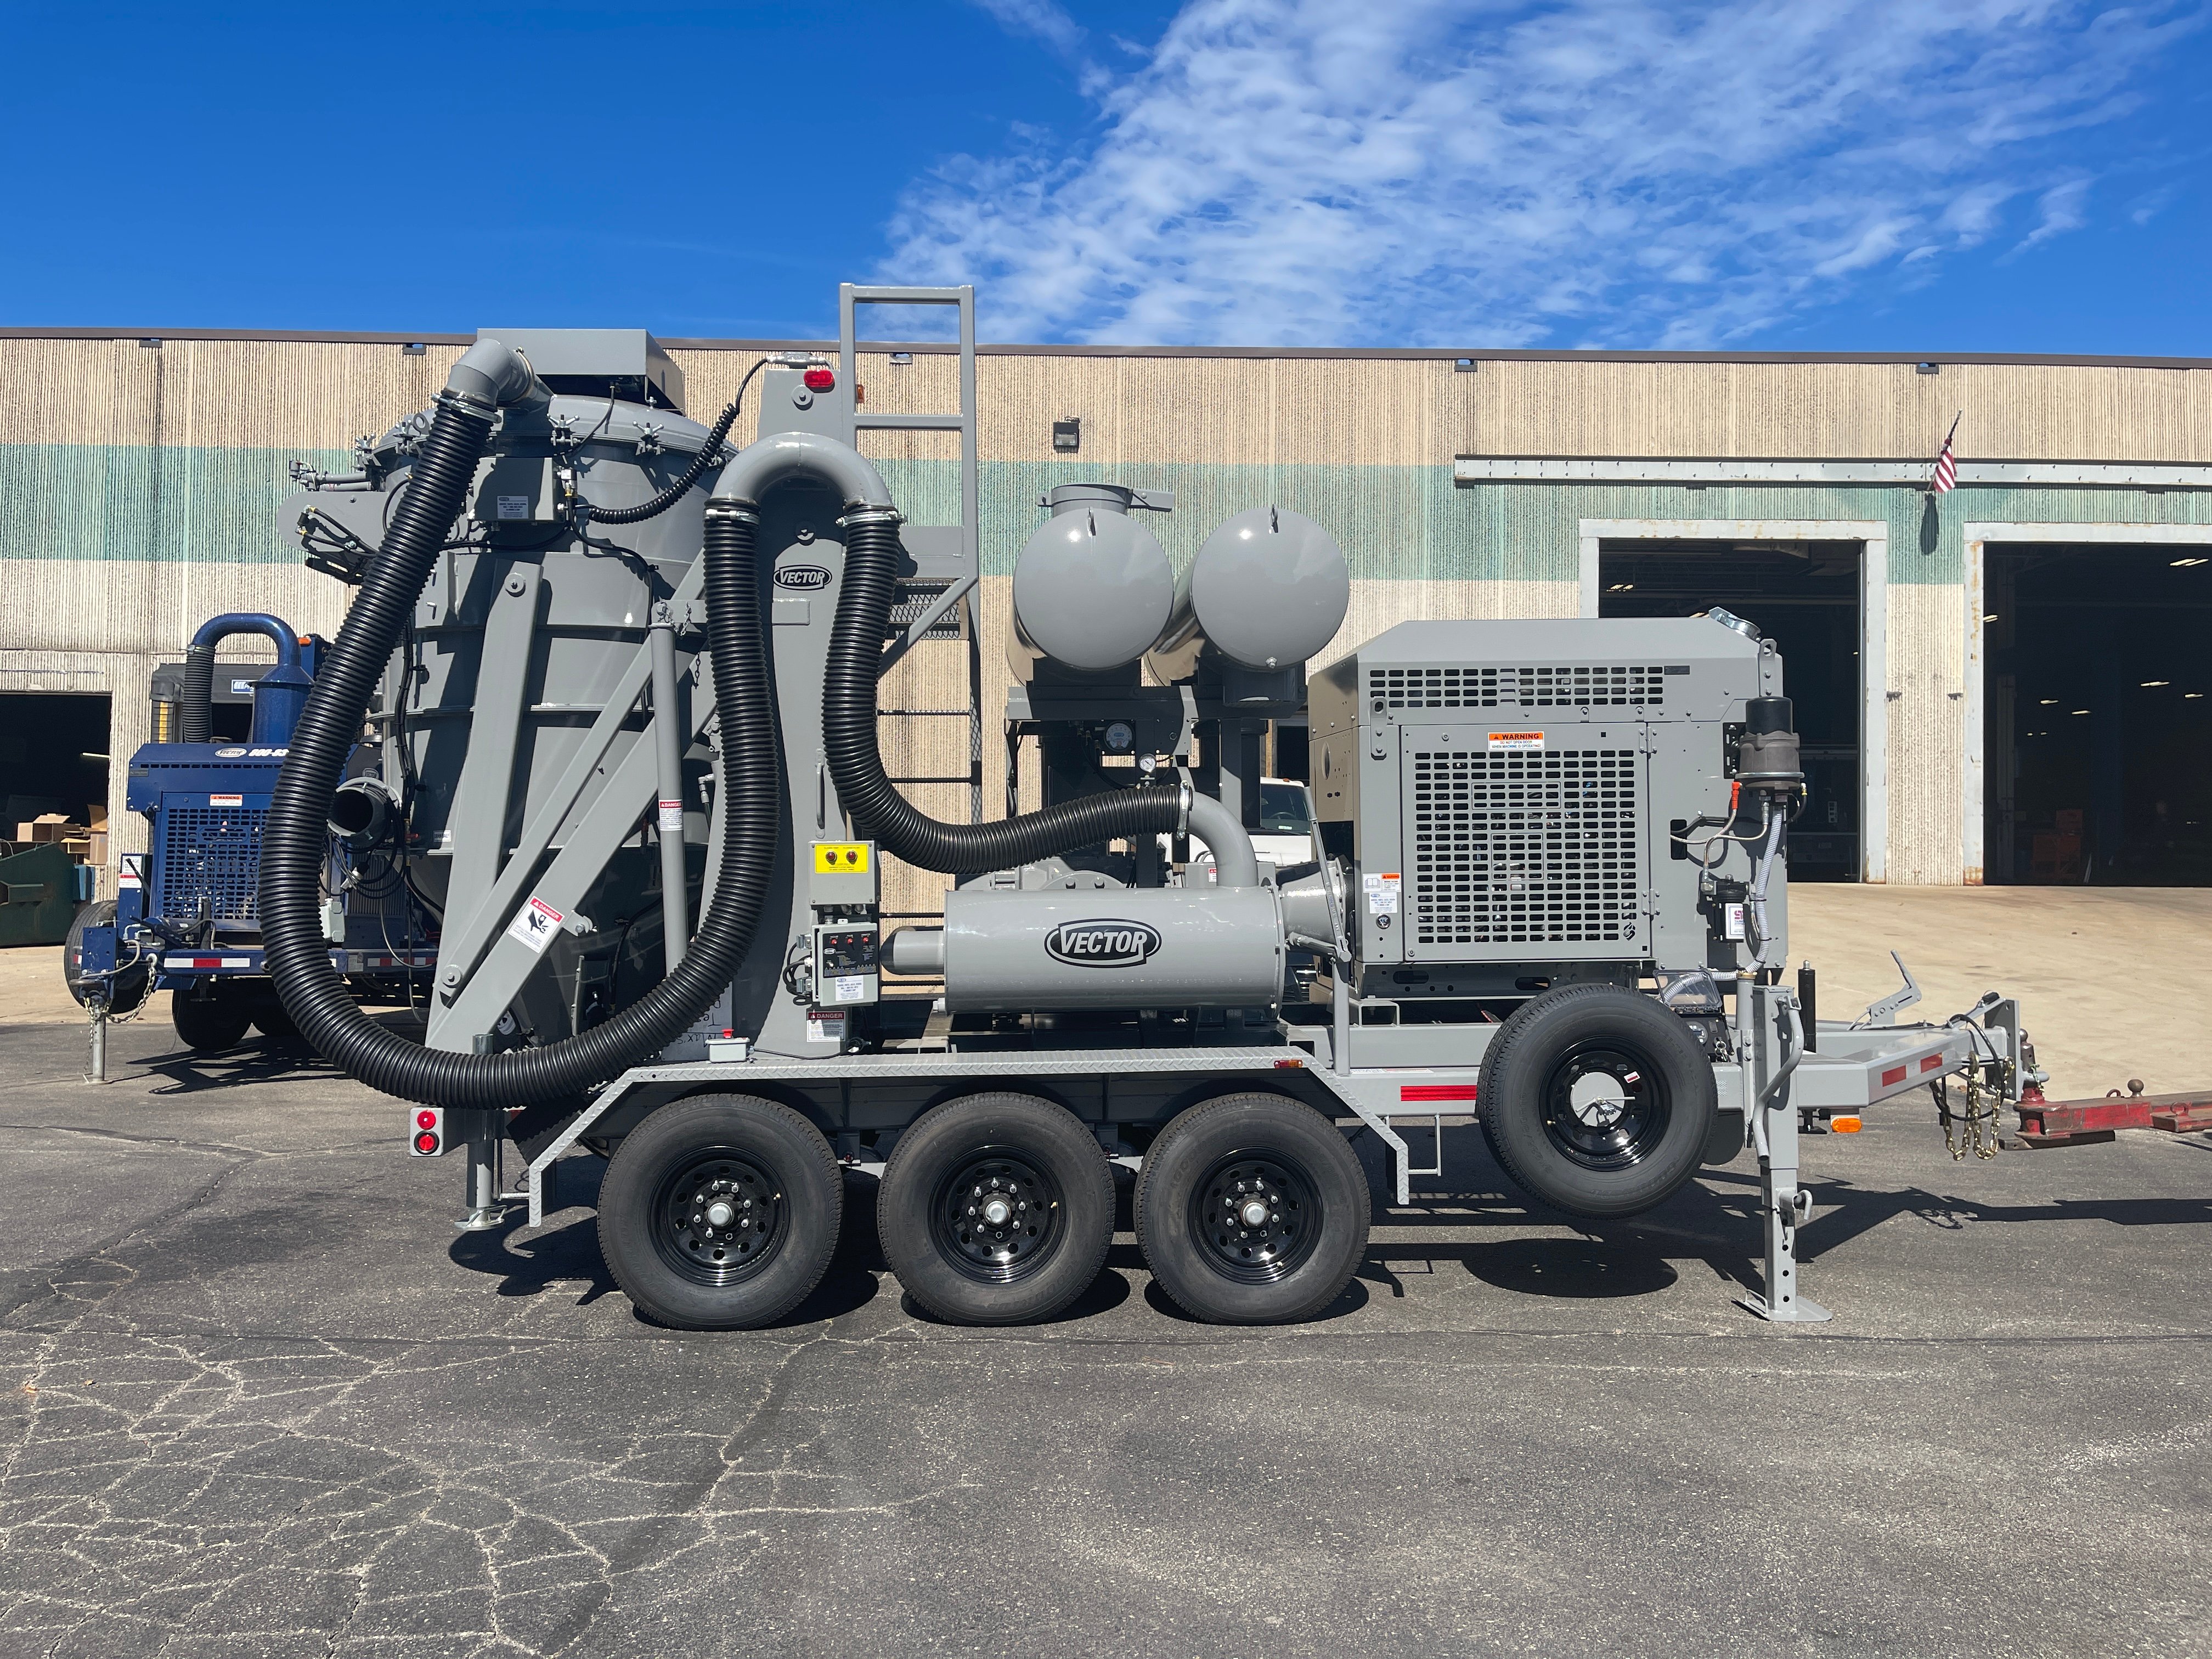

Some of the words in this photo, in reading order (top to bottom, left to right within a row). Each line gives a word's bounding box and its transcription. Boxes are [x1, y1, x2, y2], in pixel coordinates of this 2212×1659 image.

[780, 570, 825, 584] VECTOR
[538, 904, 560, 920] DANGER
[1060, 930, 1148, 955] VECTOR
